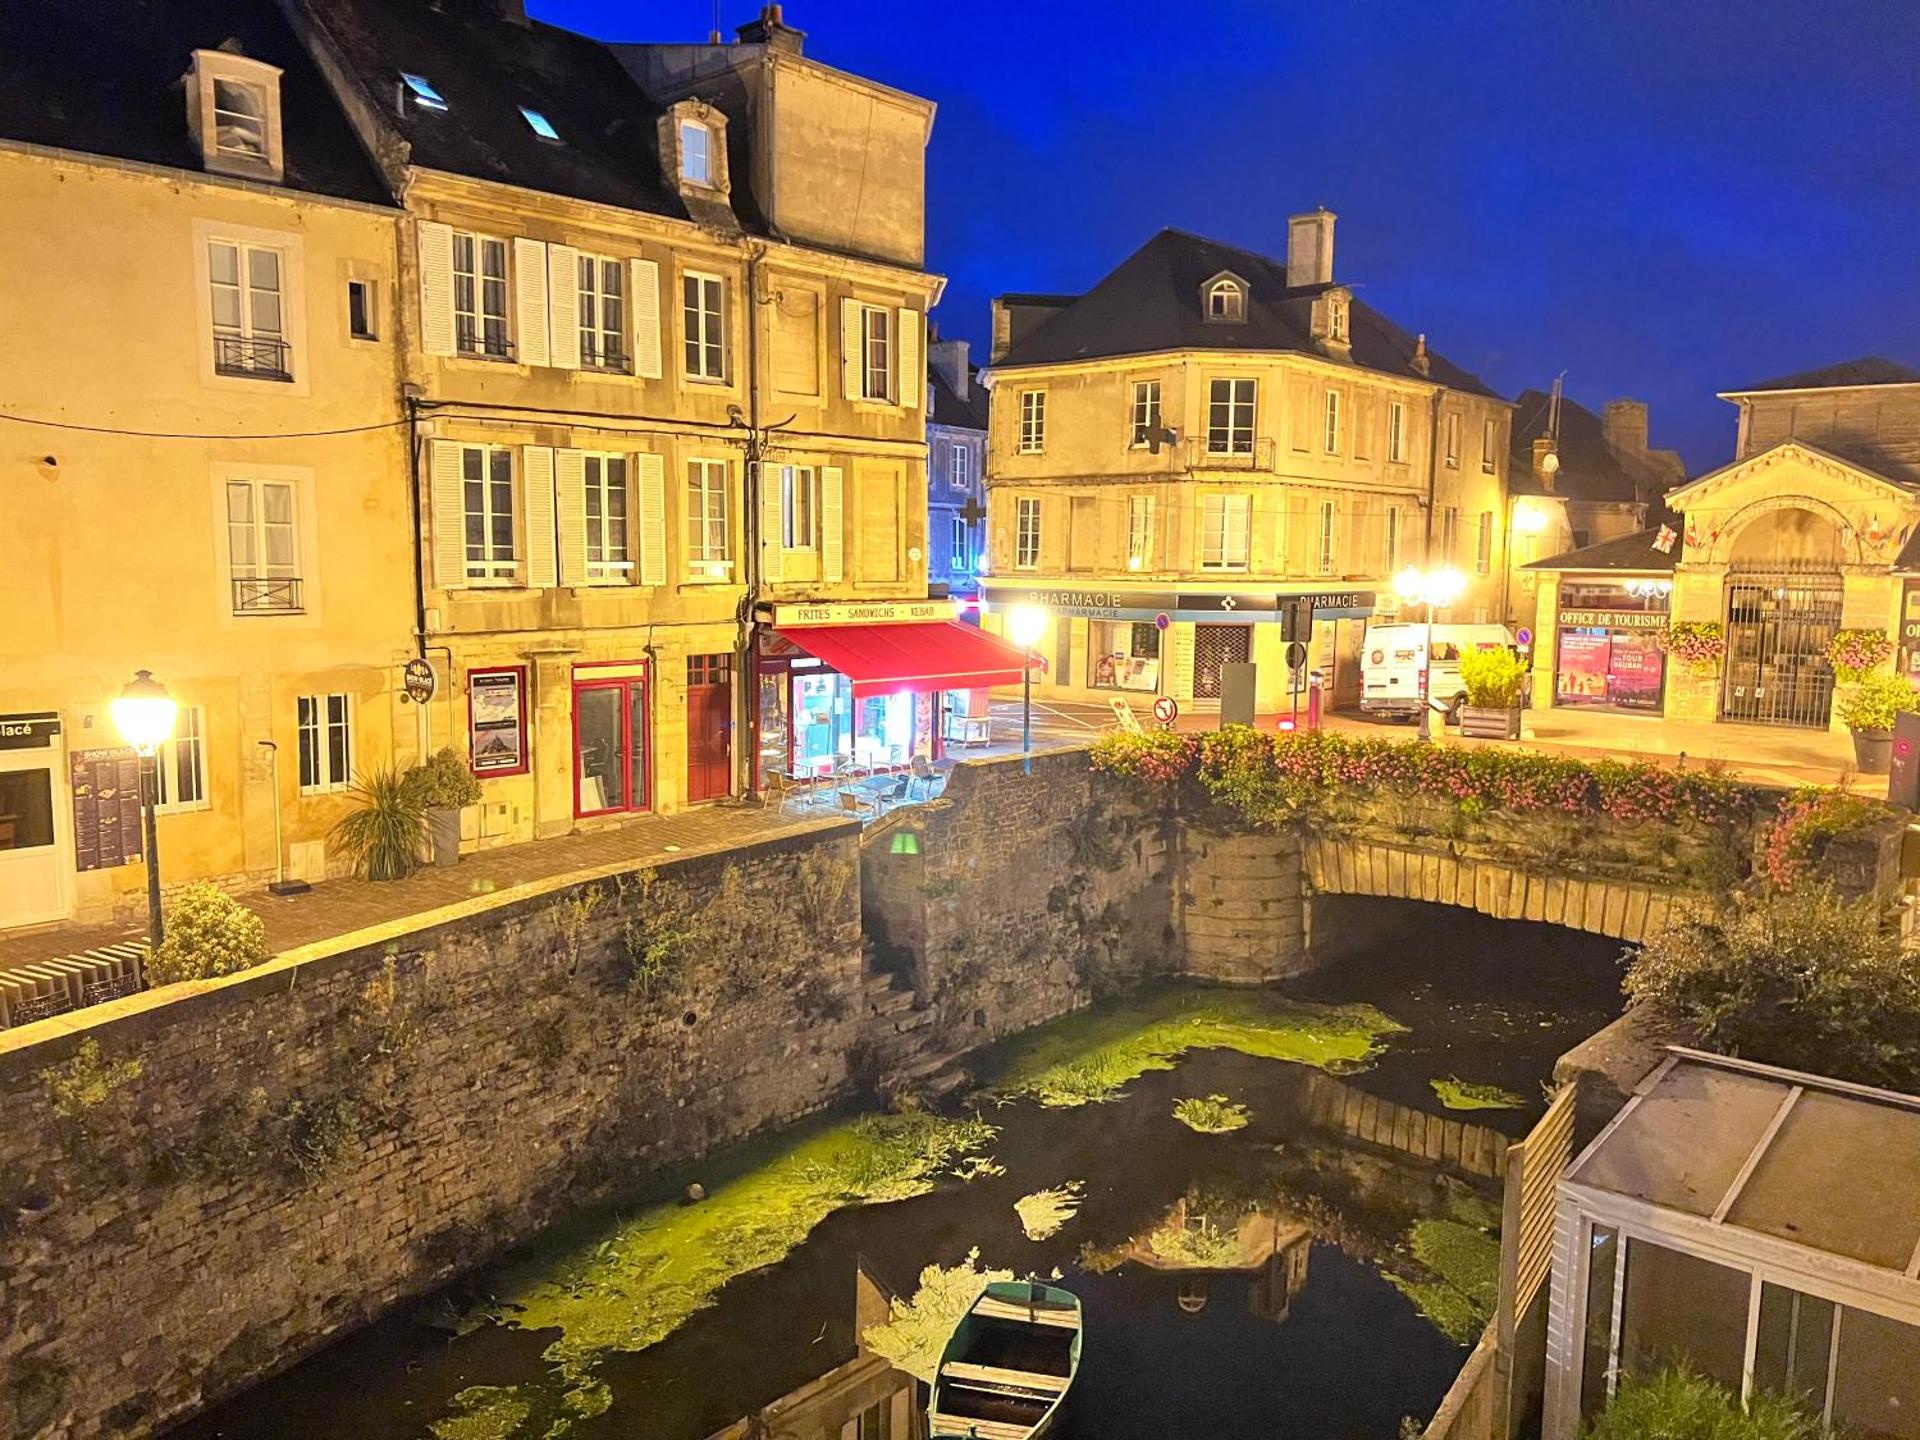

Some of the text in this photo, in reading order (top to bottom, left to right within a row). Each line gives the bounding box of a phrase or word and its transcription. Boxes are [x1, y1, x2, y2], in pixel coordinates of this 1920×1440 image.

[1030, 592, 1121, 607] PHARMACIE
[798, 609, 830, 620] FRITES
[1055, 607, 1119, 617] APHARMACIE
[1560, 612, 1667, 627] OFFICE DE TOURISME
[0, 723, 32, 737] lacé
